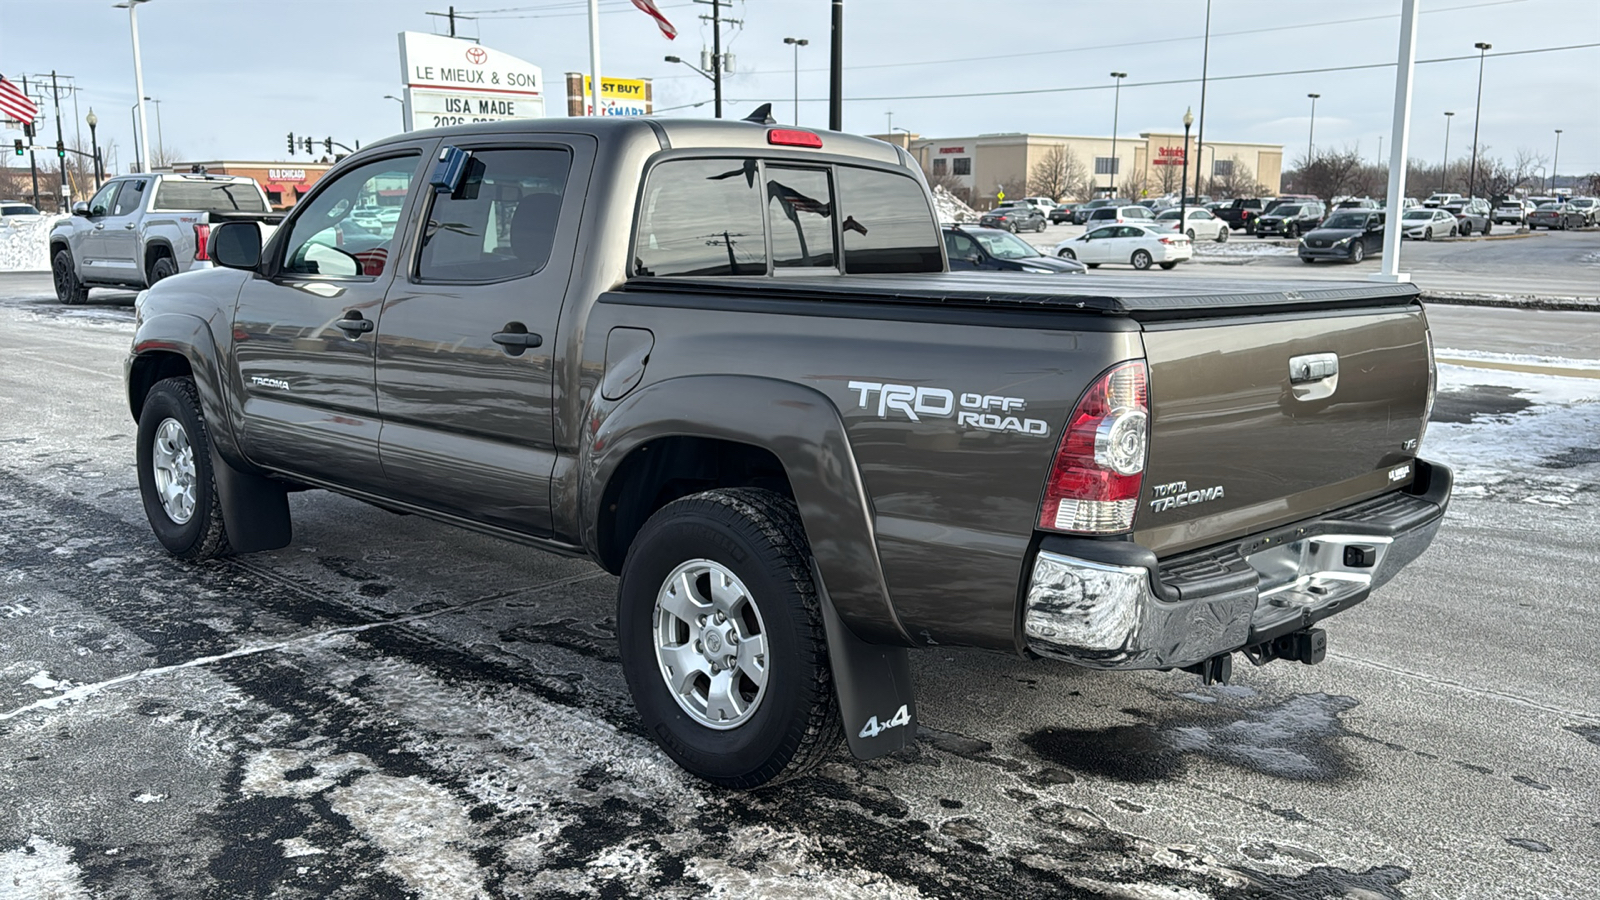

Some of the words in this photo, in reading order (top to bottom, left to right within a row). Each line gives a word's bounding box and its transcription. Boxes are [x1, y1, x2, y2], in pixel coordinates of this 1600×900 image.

[416, 66, 434, 80] LE
[441, 67, 485, 84] MIEUX
[491, 71, 500, 84] &
[507, 72, 536, 87] SON
[617, 84, 640, 94] BUY
[445, 98, 471, 113] USA
[479, 100, 515, 115] MADE
[268, 169, 281, 179] OLD
[281, 169, 306, 179] CHICAGO
[251, 376, 290, 390] TACOMA
[848, 380, 955, 423] TRD
[960, 392, 1027, 413] OFF
[957, 411, 1051, 437] ROAD
[1149, 485, 1225, 513] TACOMA
[1153, 480, 1187, 498] TOYOTA
[858, 704, 912, 738] 4x4
